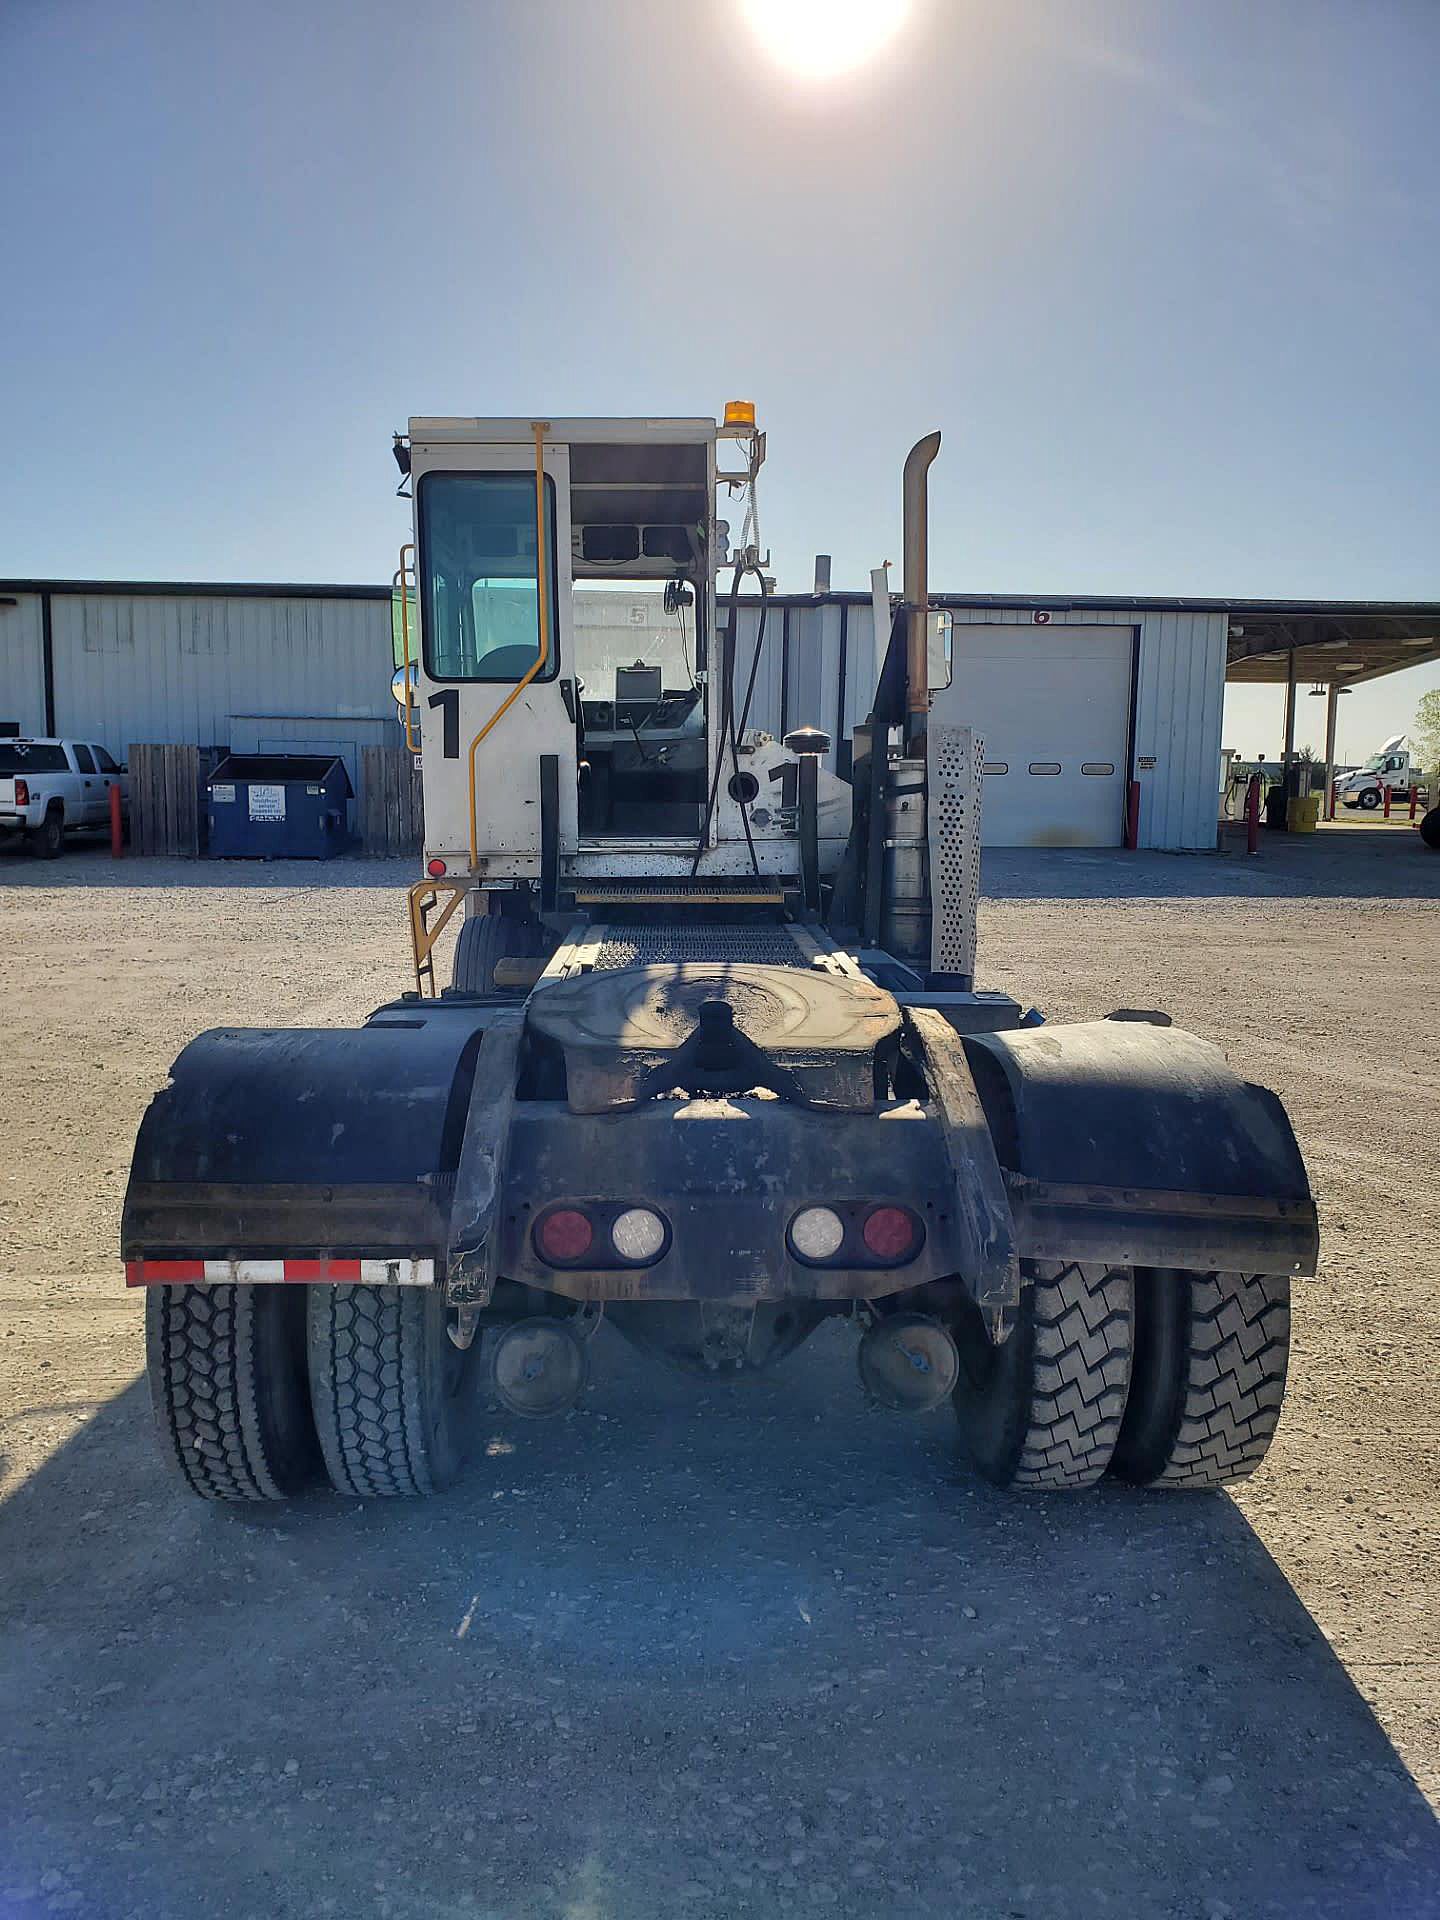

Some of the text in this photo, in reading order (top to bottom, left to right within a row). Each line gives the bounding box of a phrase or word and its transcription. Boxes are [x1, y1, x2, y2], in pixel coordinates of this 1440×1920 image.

[630, 607, 646, 624] 5
[1033, 610, 1050, 624] 6
[428, 689, 459, 758] 1
[768, 762, 798, 830] 1
